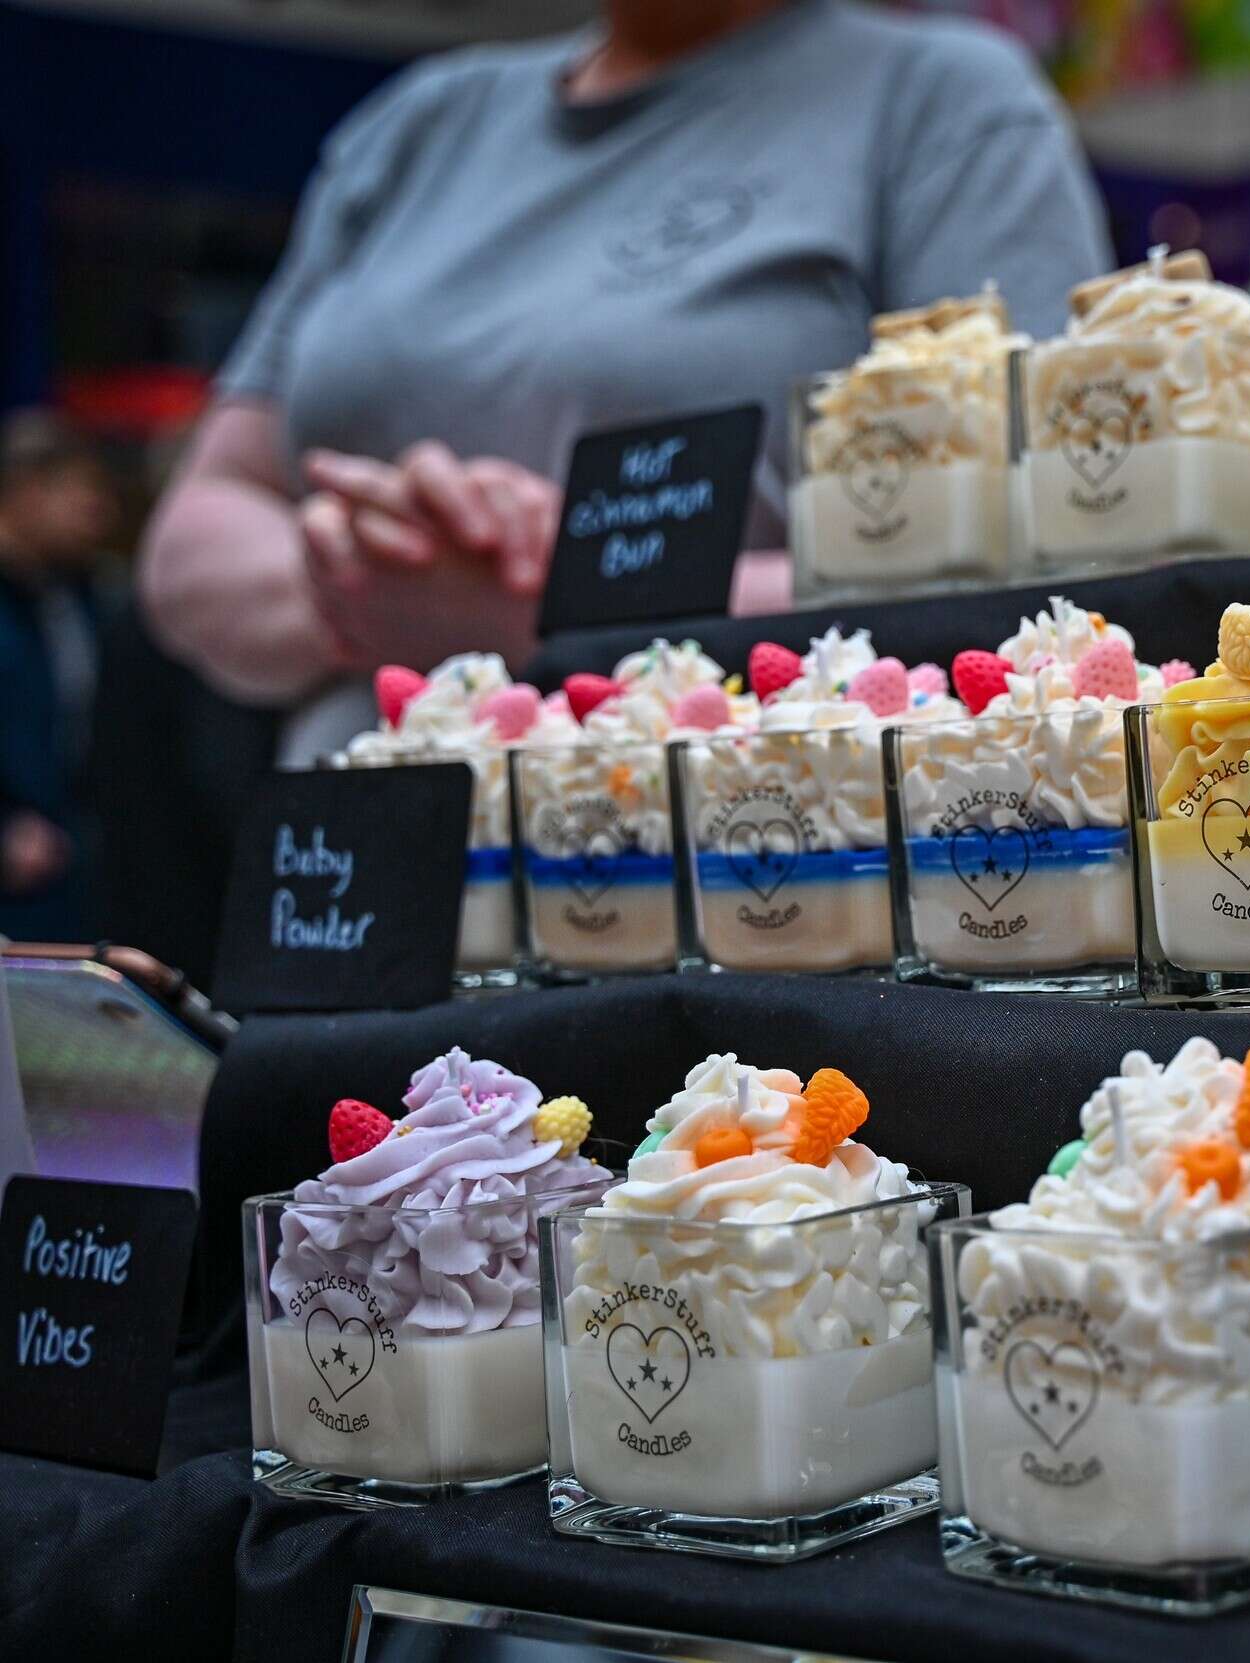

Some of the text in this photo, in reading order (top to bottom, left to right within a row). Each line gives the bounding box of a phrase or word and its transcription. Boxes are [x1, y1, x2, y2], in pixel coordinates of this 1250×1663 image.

[272, 888, 376, 950] Powder
[958, 912, 1028, 939] Candles
[24, 1214, 131, 1285] Positive
[19, 1307, 94, 1367] Vibes
[290, 1271, 397, 1354] StinkerStuff
[585, 1282, 716, 1359] StinkerStuff
[308, 1397, 370, 1433] Candles
[618, 1423, 692, 1456] Candles
